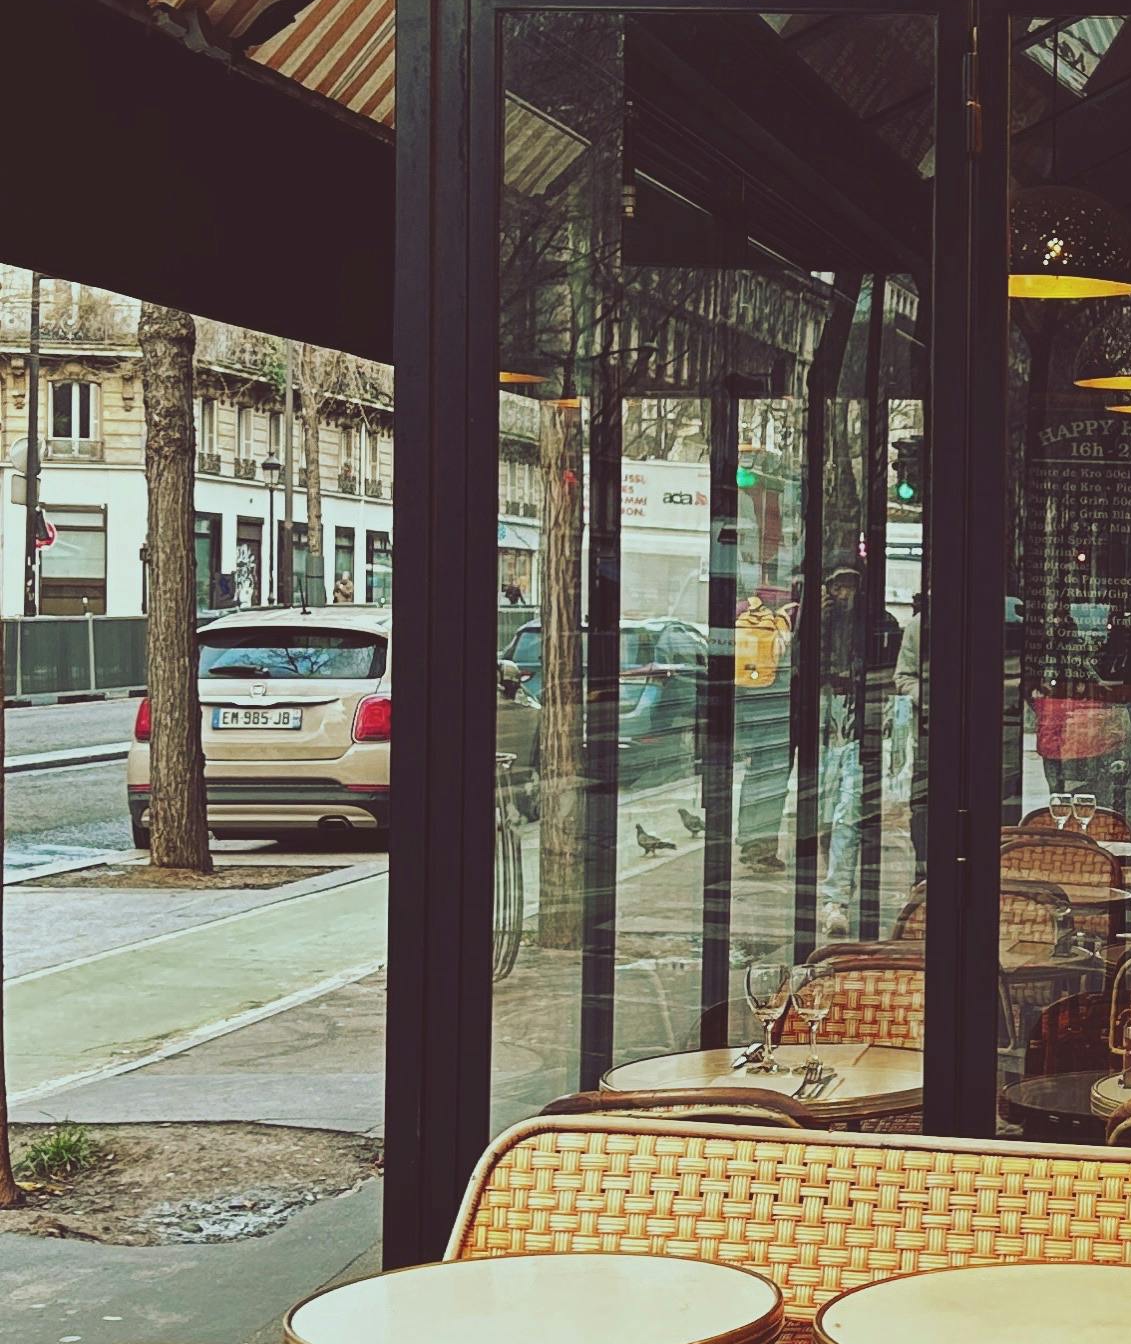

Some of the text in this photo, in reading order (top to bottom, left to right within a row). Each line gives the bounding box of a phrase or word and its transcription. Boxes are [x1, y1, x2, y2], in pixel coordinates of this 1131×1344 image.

[1039, 419, 1115, 447] HAPPY
[1071, 442, 1104, 457] 16h
[662, 491, 693, 506] ada
